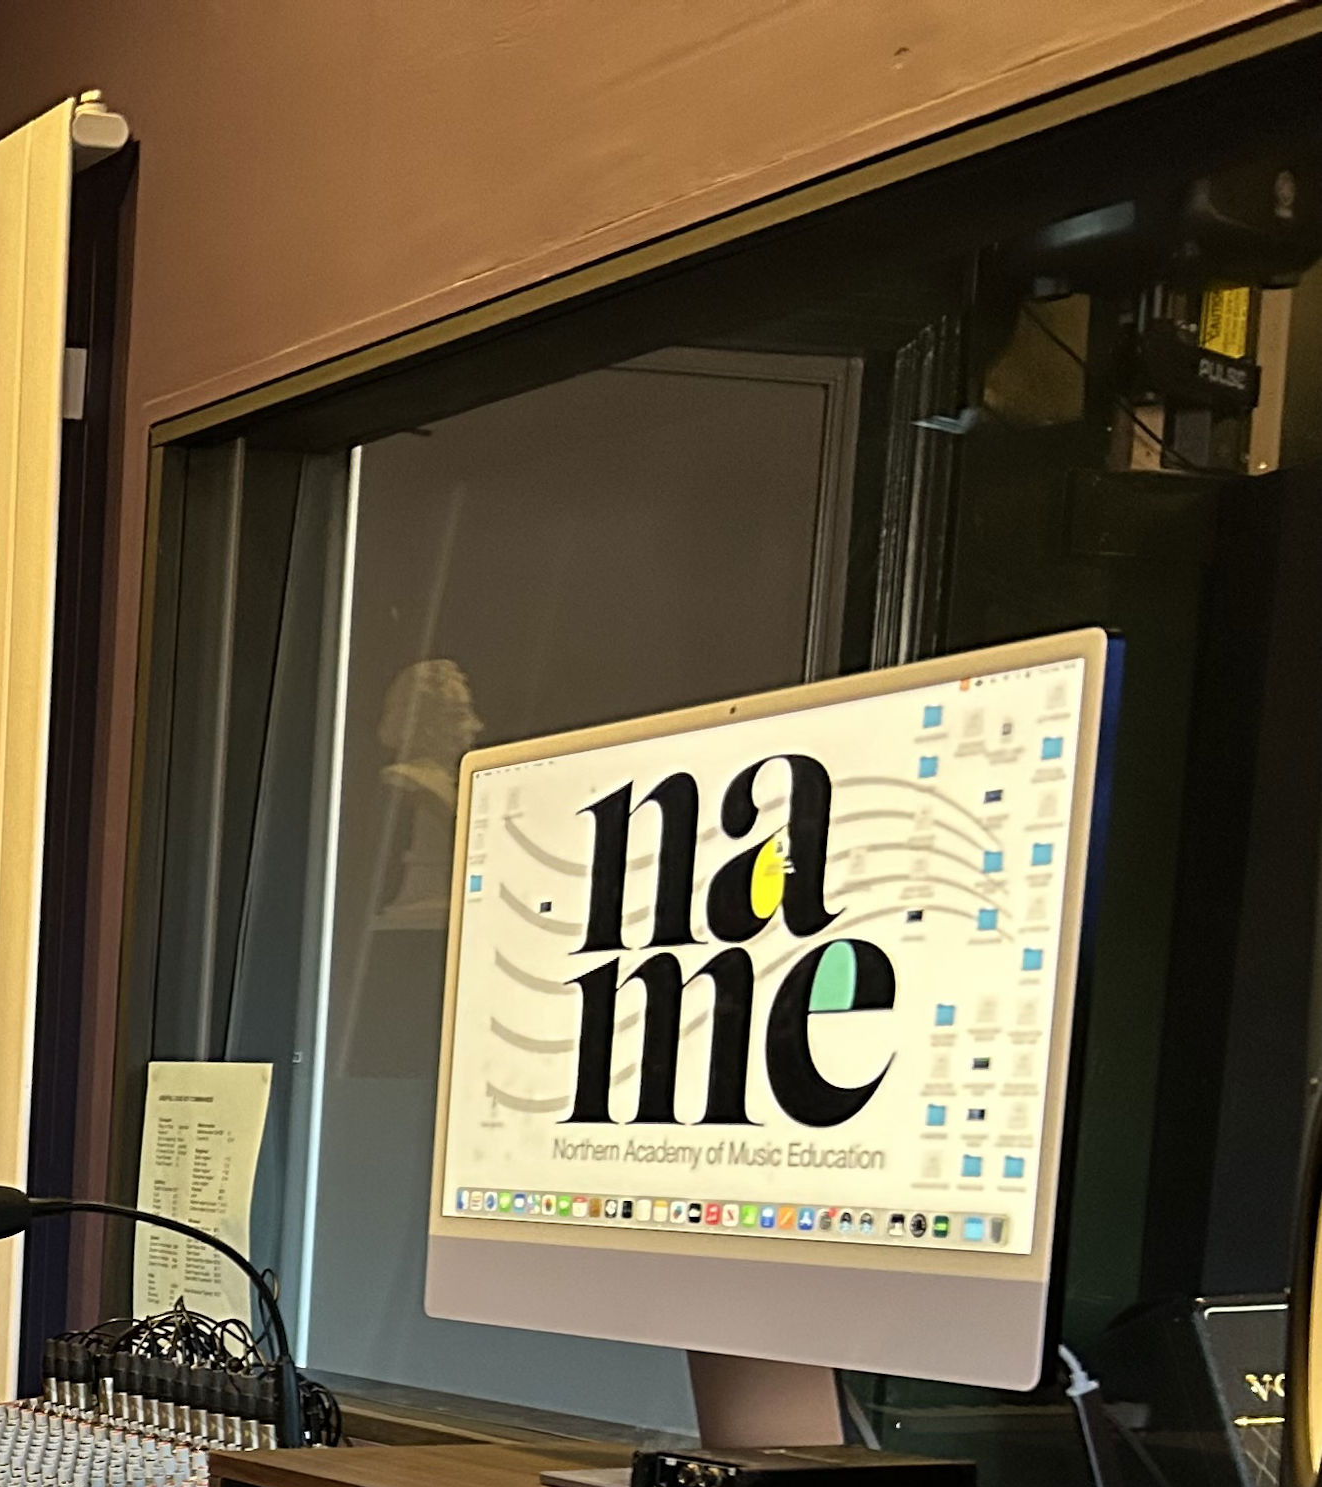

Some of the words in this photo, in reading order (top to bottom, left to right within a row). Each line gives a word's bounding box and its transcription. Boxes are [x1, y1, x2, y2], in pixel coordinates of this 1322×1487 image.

[1198, 358, 1246, 389] PULSE
[569, 754, 846, 955] na
[556, 938, 897, 1128] me
[552, 1138, 620, 1161] Northern
[622, 1139, 703, 1171] Academy
[706, 1140, 725, 1165] of
[728, 1141, 782, 1167] Music
[786, 1142, 886, 1170] Education
